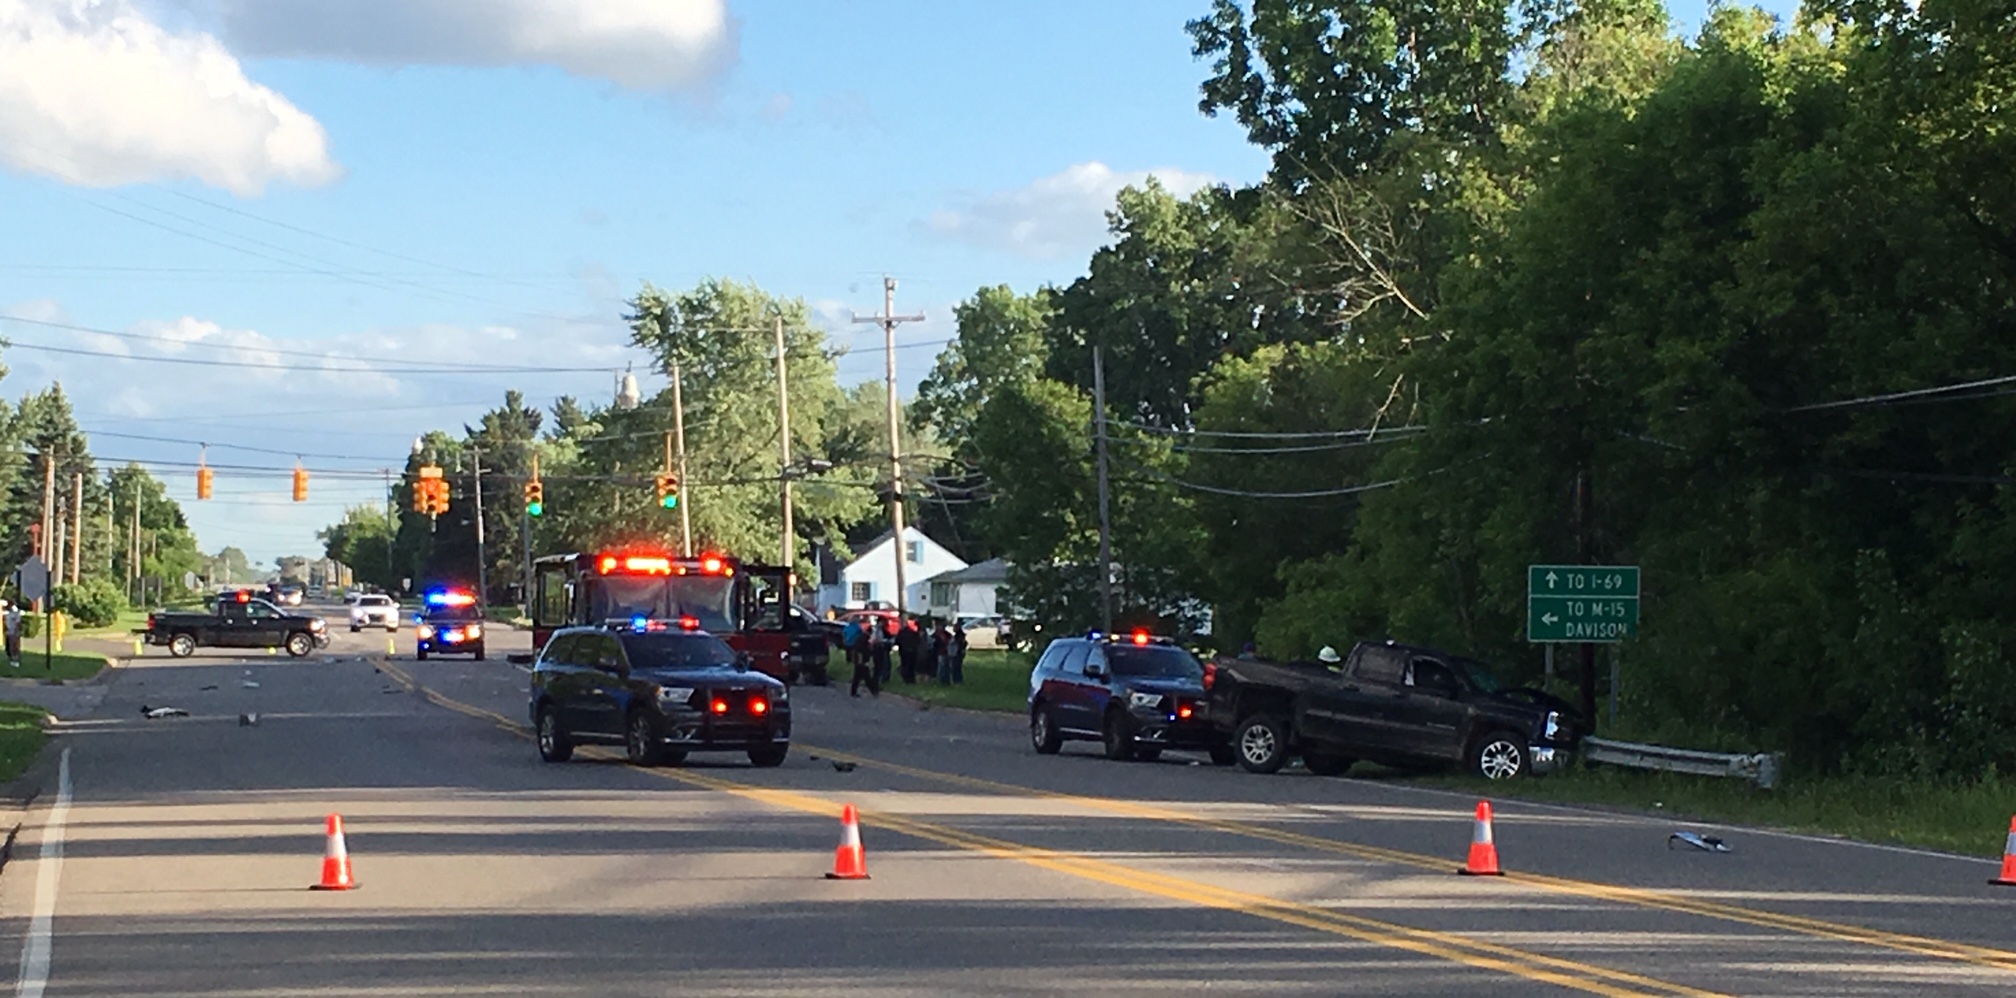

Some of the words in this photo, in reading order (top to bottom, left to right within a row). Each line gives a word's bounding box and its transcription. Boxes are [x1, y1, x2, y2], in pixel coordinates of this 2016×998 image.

[1567, 574, 1584, 589] TO
[1592, 574, 1622, 589] I-69
[1566, 601, 1584, 616] TO
[1592, 602, 1625, 617] M-15
